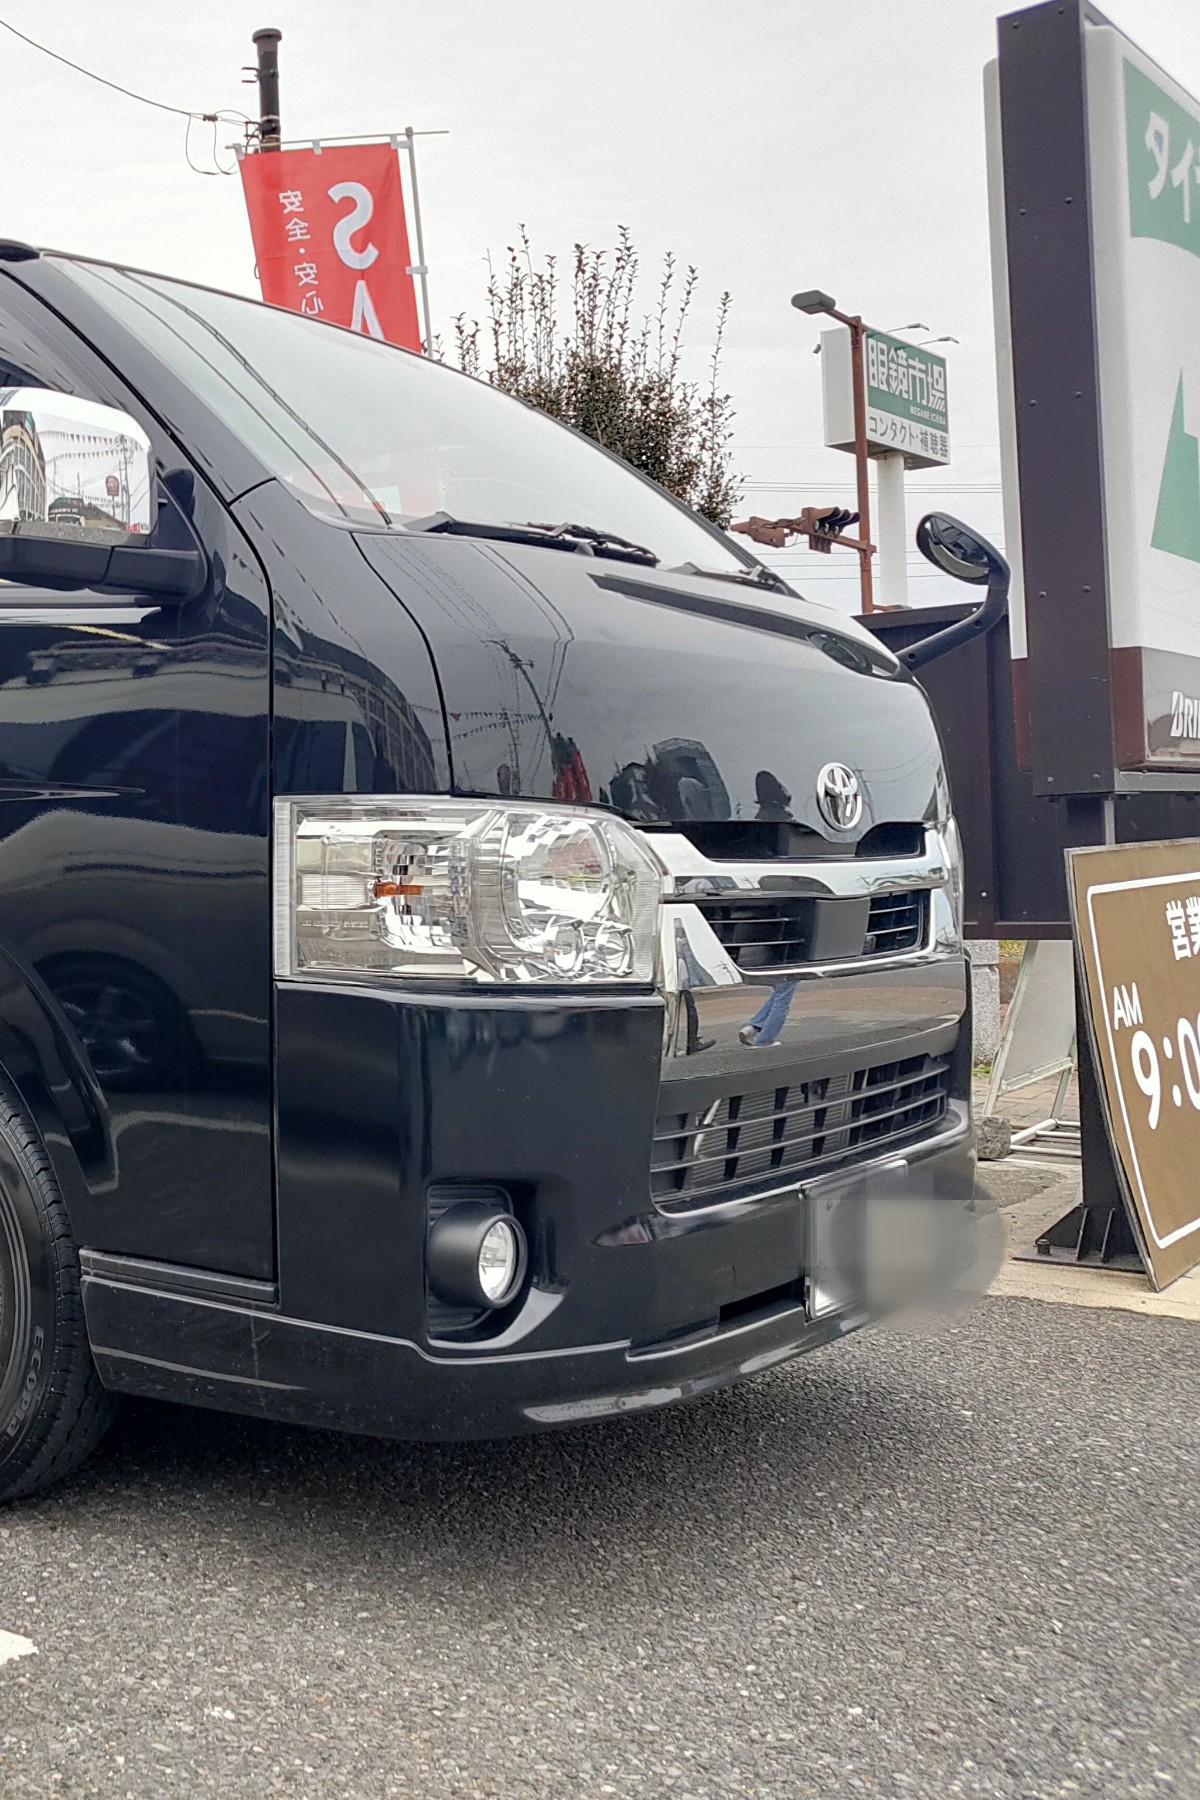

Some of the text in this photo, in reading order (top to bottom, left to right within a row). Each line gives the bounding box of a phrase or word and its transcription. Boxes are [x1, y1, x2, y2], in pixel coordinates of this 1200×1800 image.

[1144, 109, 1200, 224] タイ
[867, 337, 947, 413] 眼鏡市場
[1170, 690, 1200, 739] BRI
[1113, 982, 1144, 1031] AM
[1131, 1011, 1200, 1130] 9:0
